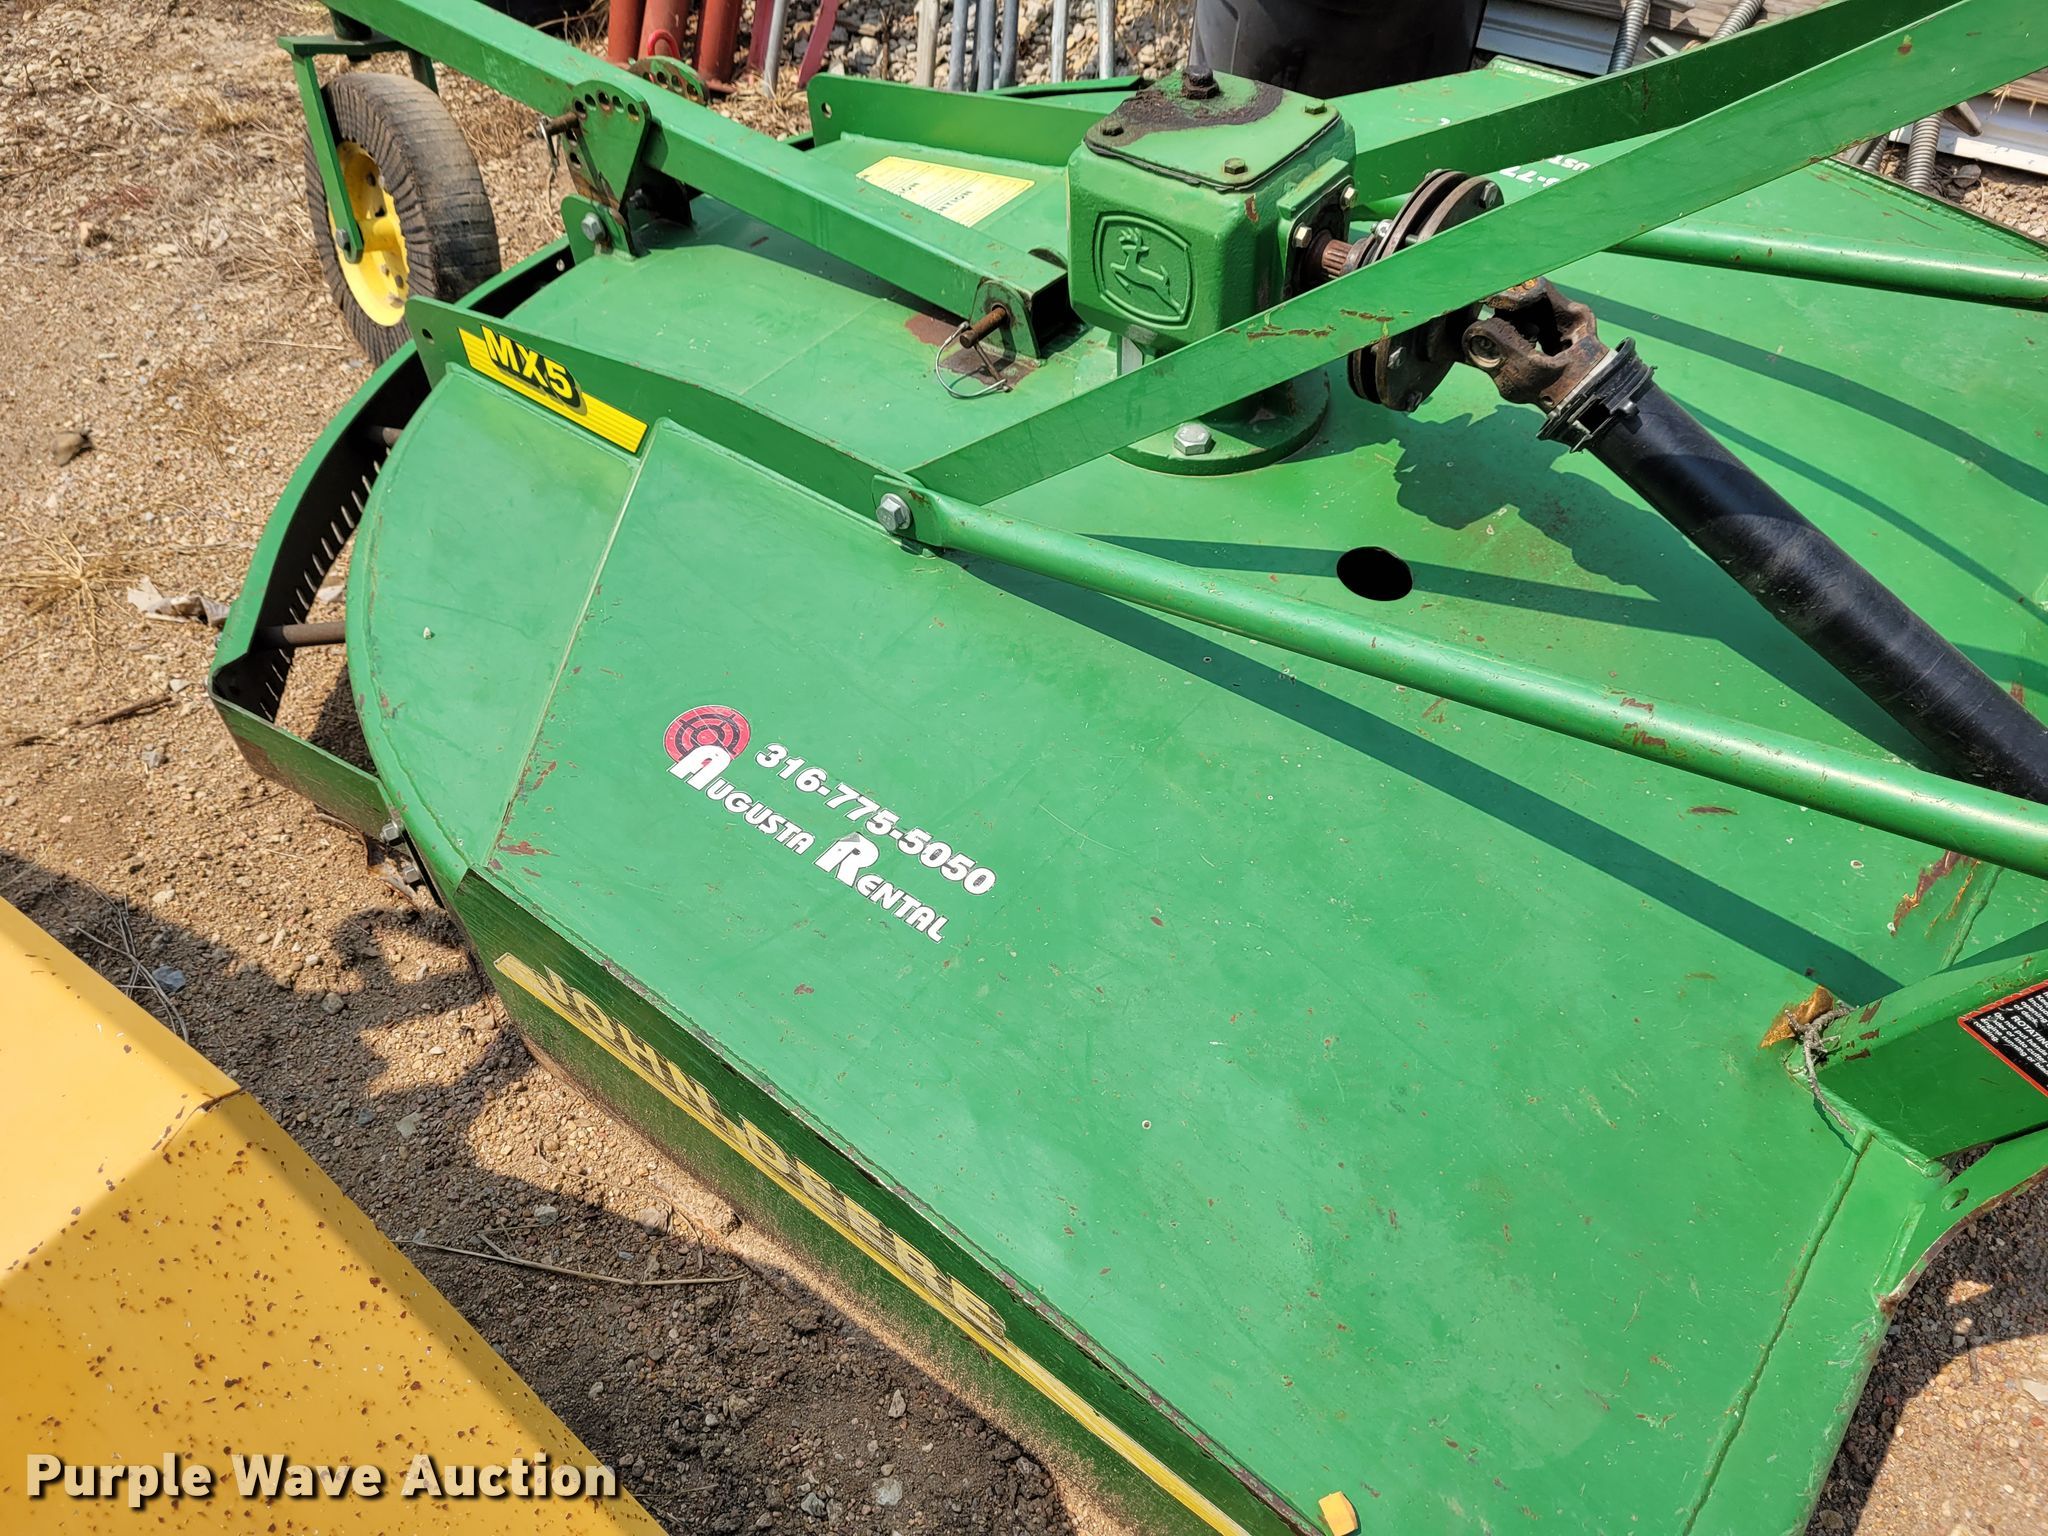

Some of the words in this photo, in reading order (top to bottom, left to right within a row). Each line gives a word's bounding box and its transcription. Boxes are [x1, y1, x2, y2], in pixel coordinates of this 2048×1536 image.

[480, 324, 581, 408] MX5
[667, 744, 816, 855] AUGUSTA
[813, 831, 949, 944] RENTAL
[755, 743, 996, 895] 316-775-5050
[532, 965, 726, 1130] JOHN
[738, 1113, 1005, 1336] DEERE
